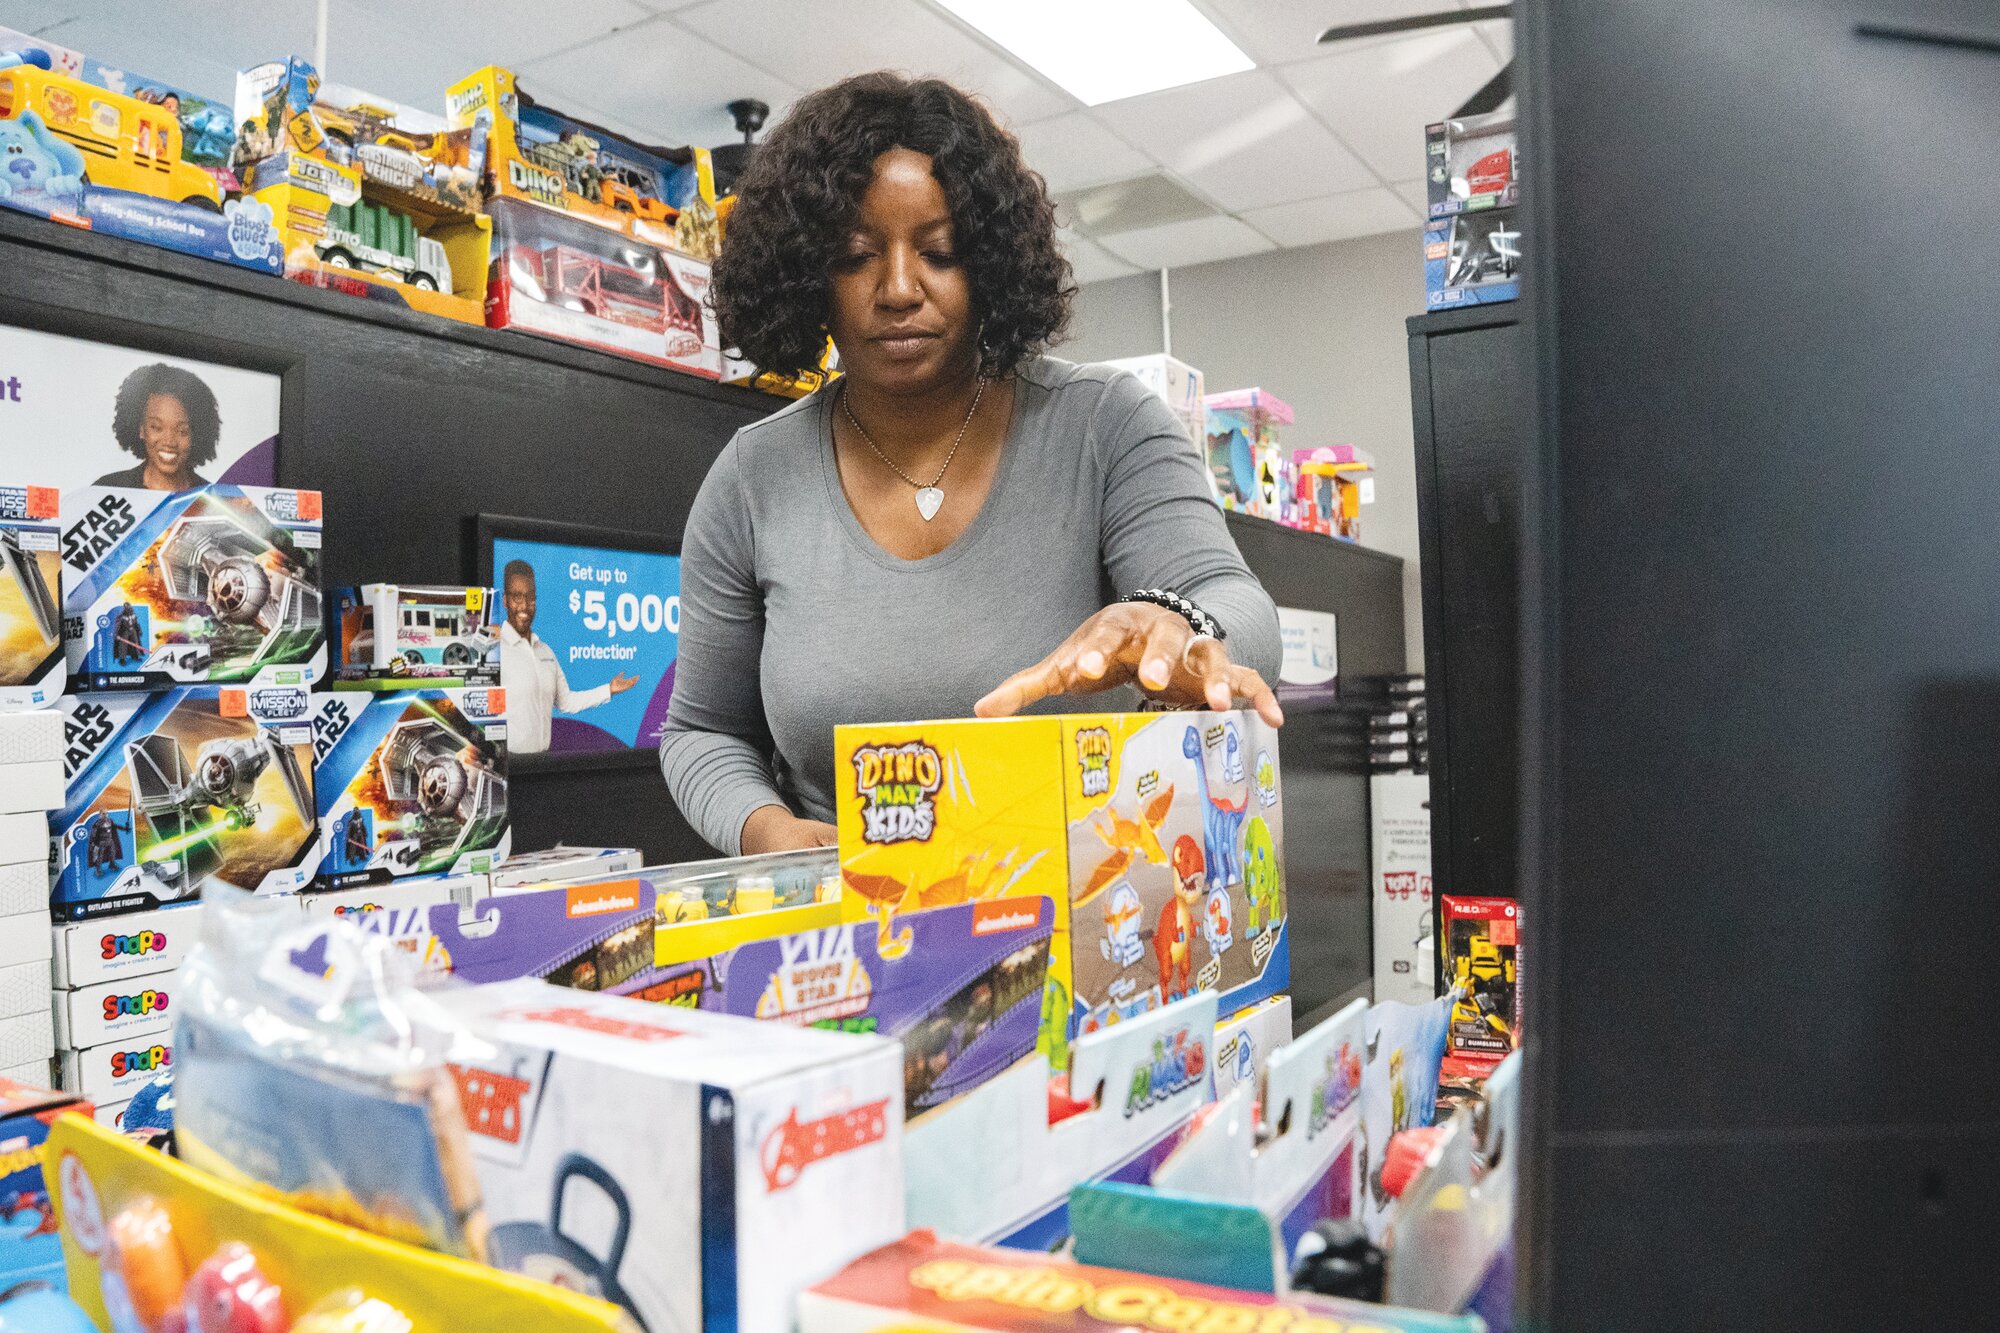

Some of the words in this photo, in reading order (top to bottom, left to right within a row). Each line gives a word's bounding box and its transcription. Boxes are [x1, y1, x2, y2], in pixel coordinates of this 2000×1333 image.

[365, 160, 417, 188] VEHICLE
[509, 159, 563, 195] DINO
[102, 202, 154, 227] Sing-Along
[156, 215, 186, 233] School
[189, 223, 205, 238] Bus
[234, 212, 270, 234] Blue's
[232, 226, 267, 247] Clues
[267, 500, 297, 511] MISS
[63, 494, 128, 561] STAR
[68, 501, 136, 573] WARS
[569, 562, 593, 581] Get
[596, 568, 612, 586] up
[614, 568, 628, 584] to
[568, 589, 681, 638] $5,000
[119, 676, 144, 684] ADVANCED
[252, 696, 305, 709] MISSION
[267, 709, 295, 717] FLEET
[464, 698, 488, 709] MISS
[65, 702, 104, 745] AR
[312, 699, 345, 736] AR
[861, 750, 938, 789] DINO
[875, 784, 921, 805] MAT
[865, 801, 934, 839] KIDS
[87, 901, 112, 912] OUTLAND
[113, 900, 122, 908] TIE
[122, 898, 144, 907] FIGHTER
[571, 896, 634, 916] nickelodeon
[976, 911, 1036, 932] nickelodeon
[103, 959, 126, 969] imagine
[132, 957, 150, 965] create
[155, 953, 168, 962] play
[792, 961, 842, 986] MOVIE
[798, 982, 836, 1004] STAR
[105, 1020, 128, 1031] imagine
[134, 1017, 152, 1026] create
[1467, 1039, 1503, 1049] BUMBLEBEE
